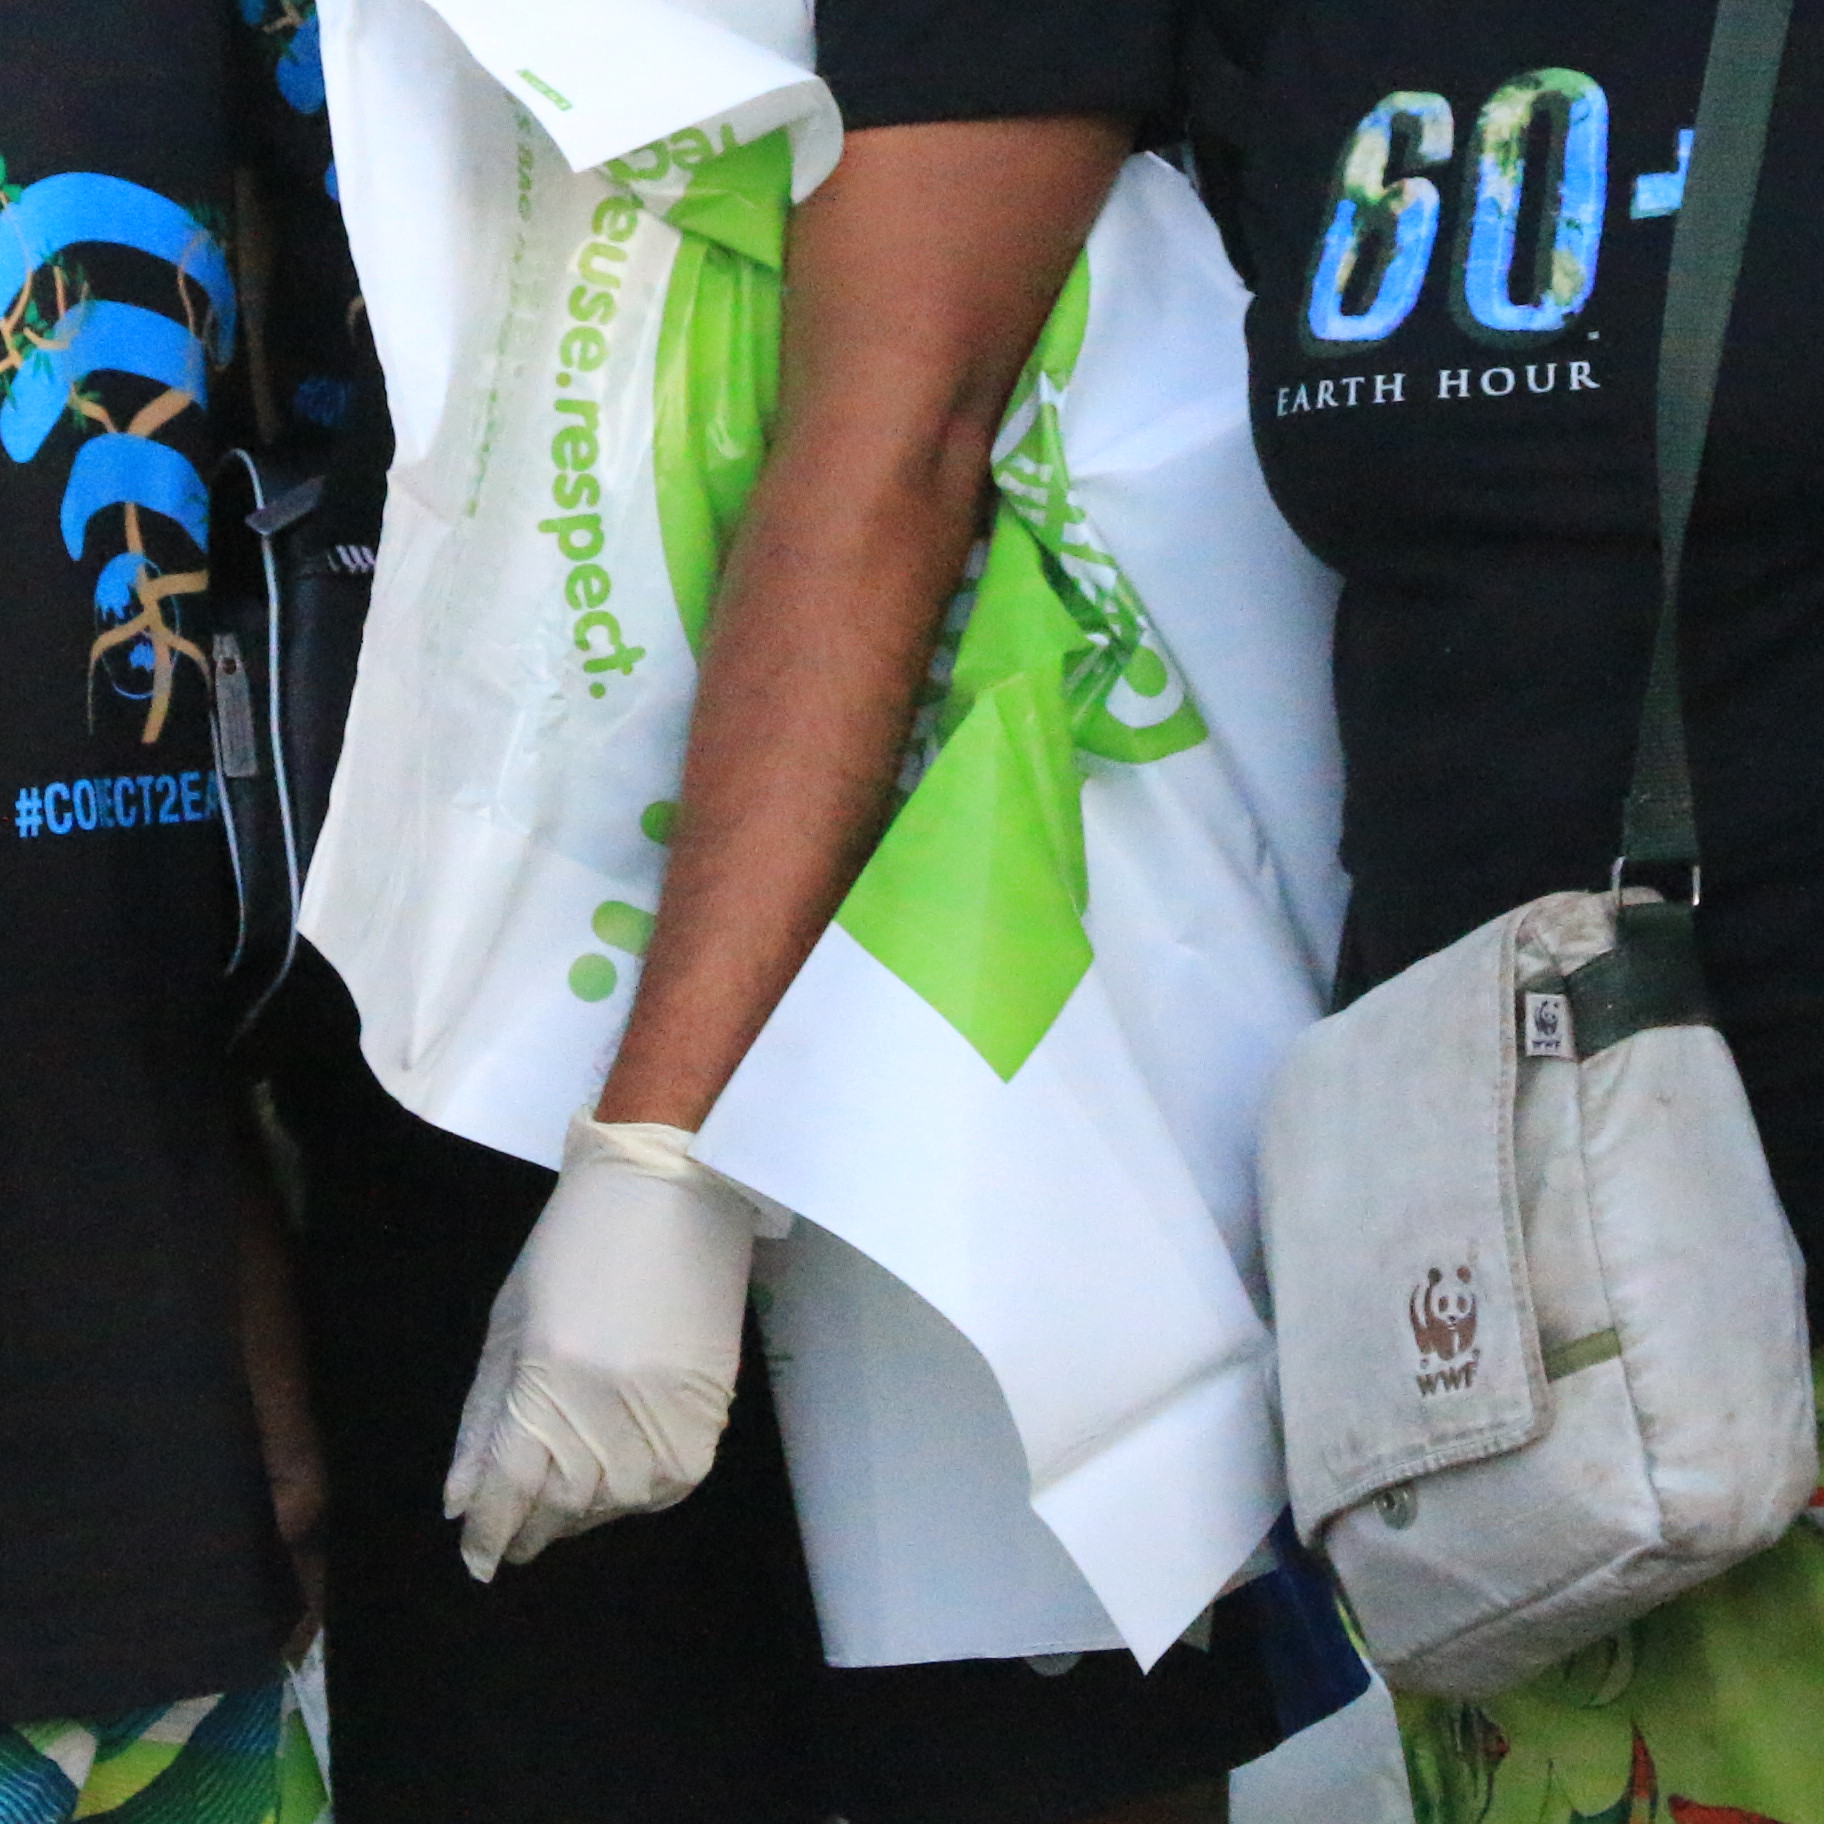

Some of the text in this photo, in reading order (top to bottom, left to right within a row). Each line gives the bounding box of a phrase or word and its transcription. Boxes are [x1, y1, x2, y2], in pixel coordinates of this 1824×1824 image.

[1277, 359, 1602, 417] EARTH HOUR
[1416, 1360, 1478, 1397] WWF
